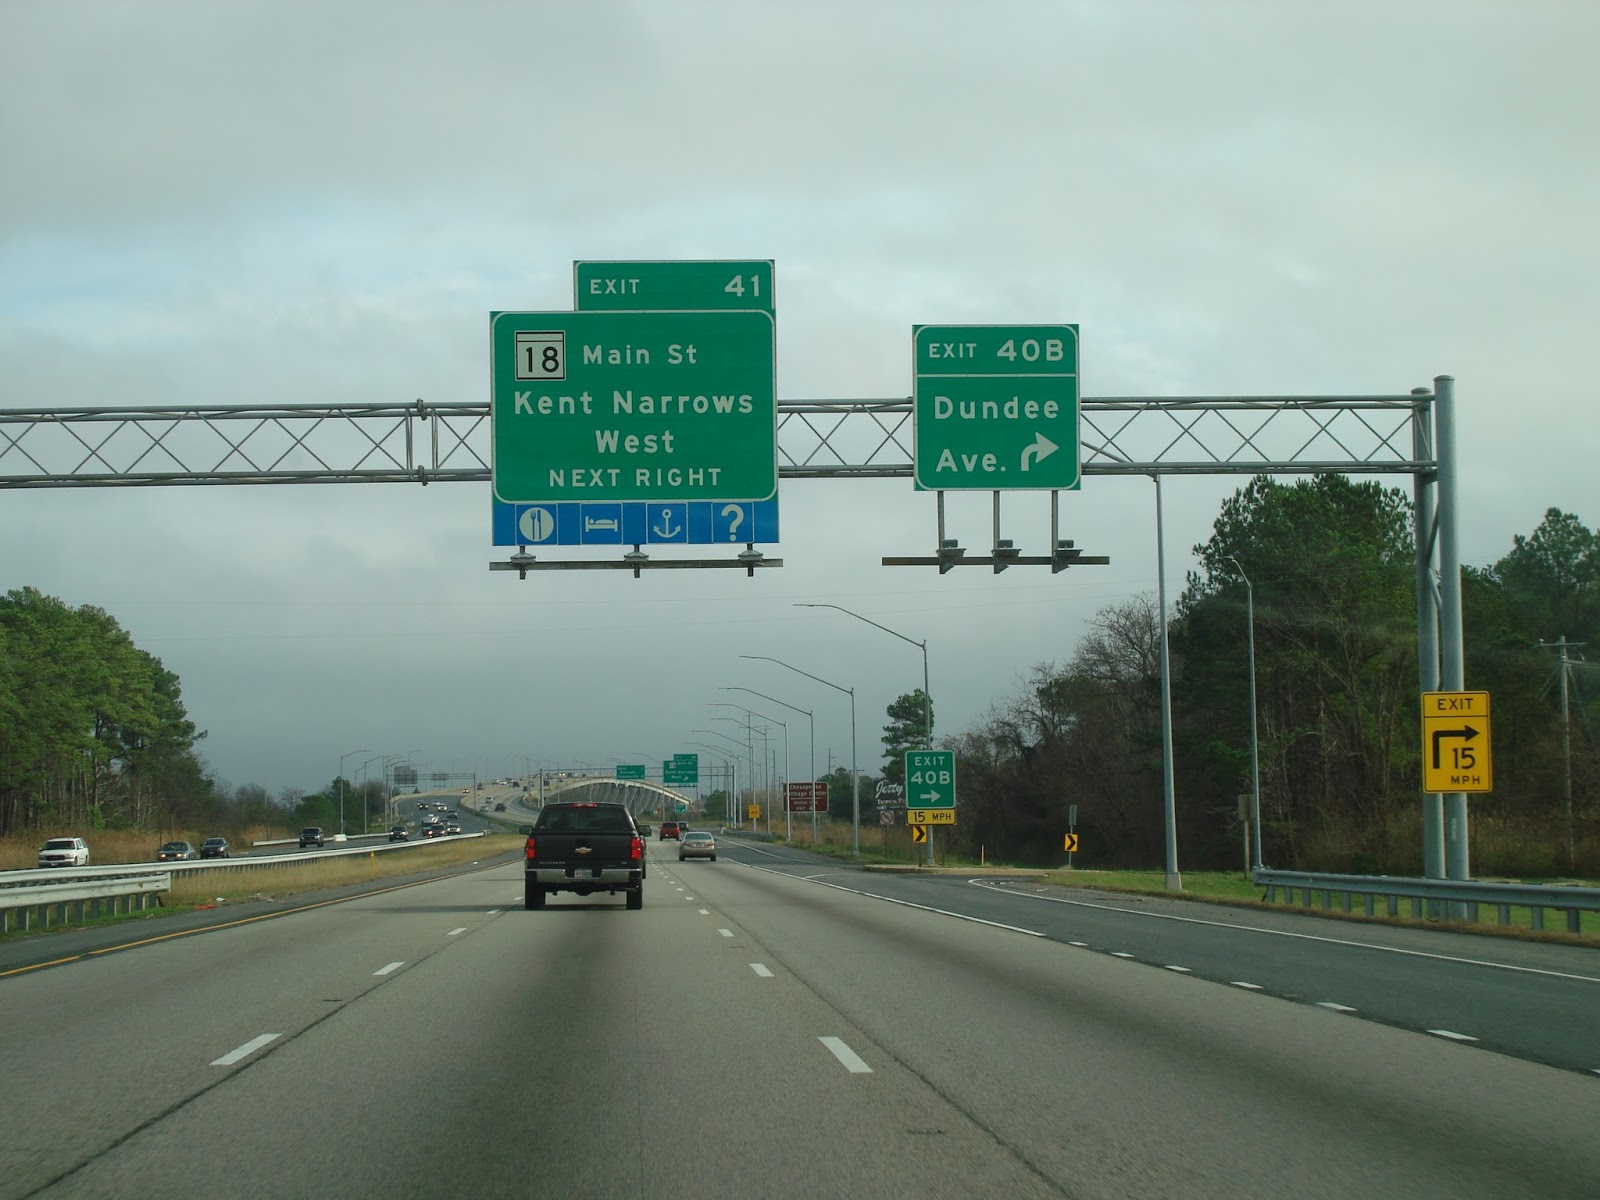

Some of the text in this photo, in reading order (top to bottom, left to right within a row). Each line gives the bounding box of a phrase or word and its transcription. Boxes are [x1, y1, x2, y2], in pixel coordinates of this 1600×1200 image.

[590, 275, 760, 297] EXIT 41
[525, 346, 560, 373] 18
[583, 344, 697, 365] Main St
[928, 339, 1064, 362] EXIT 40B
[514, 390, 753, 415] Kent Narrows
[934, 395, 1059, 420] Dundee
[595, 430, 674, 454] West
[935, 448, 1006, 472] Ave.
[549, 467, 722, 487] NEXT RIGHT
[1437, 698, 1474, 711] EXIT
[914, 756, 945, 767] EXIT
[1452, 747, 1476, 770] 15
[910, 770, 951, 785] 40B
[1450, 775, 1480, 785] MPH
[875, 780, 904, 799] Jetty
[913, 811, 952, 823] 15 MPH
